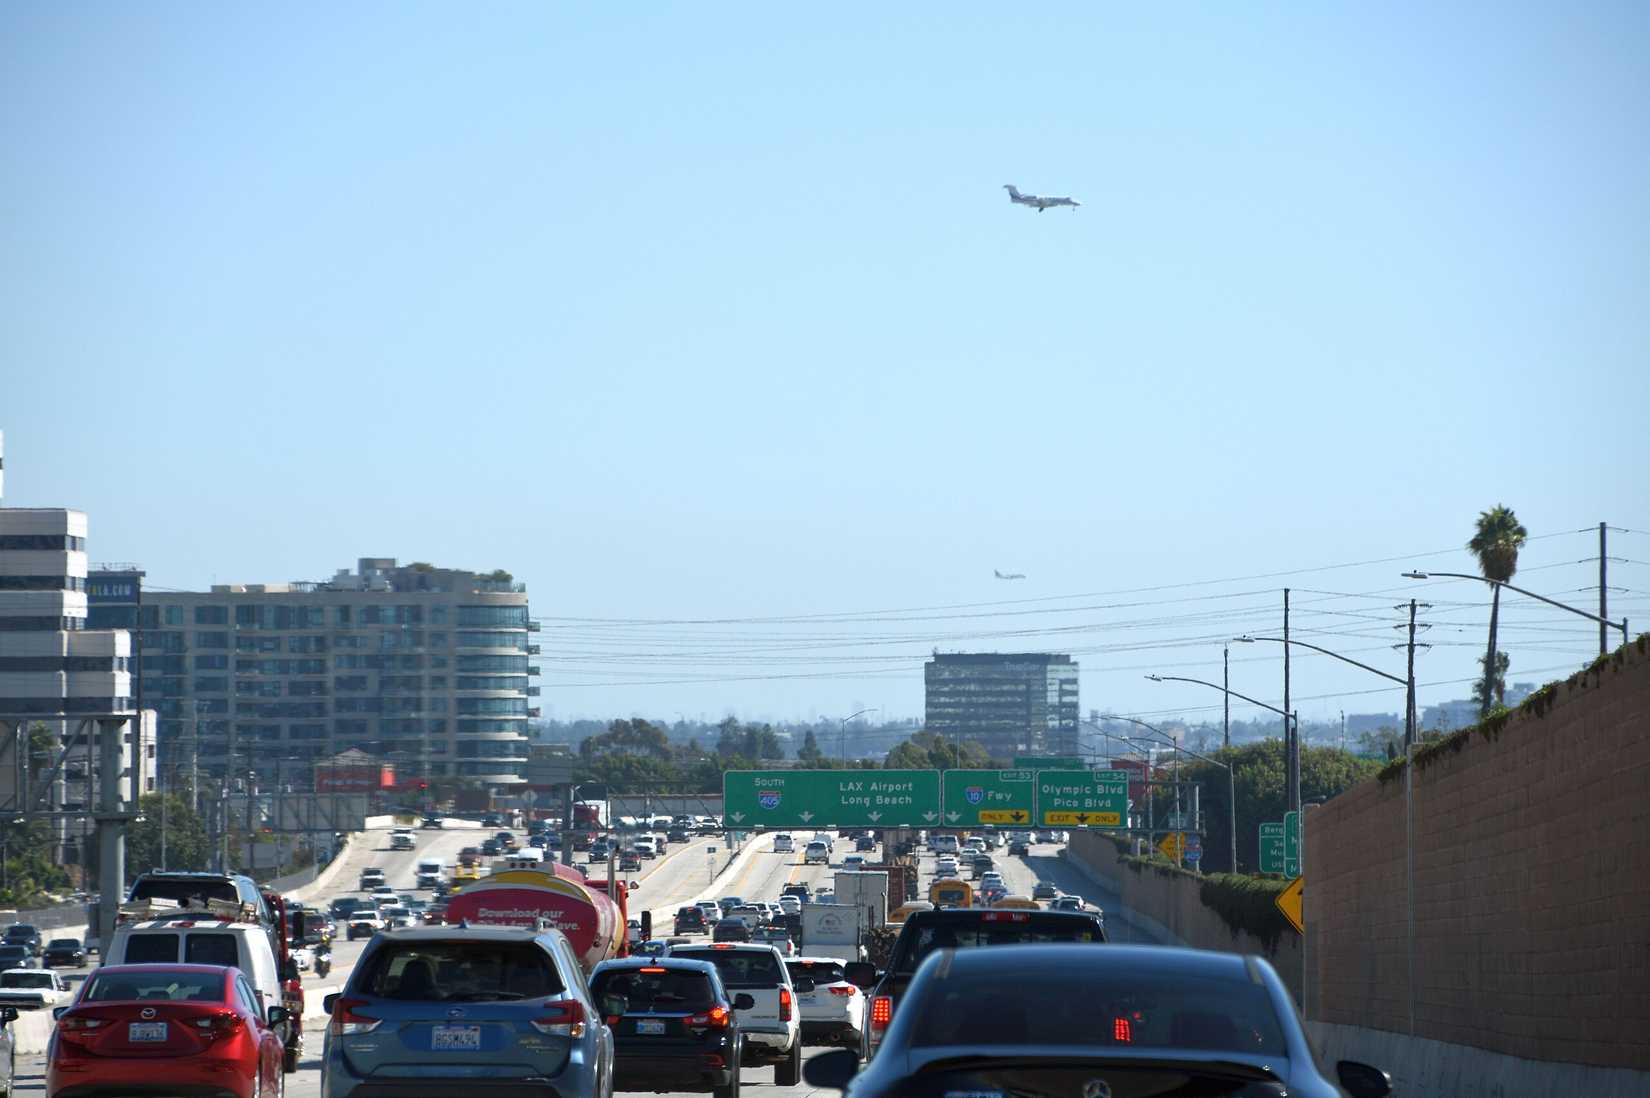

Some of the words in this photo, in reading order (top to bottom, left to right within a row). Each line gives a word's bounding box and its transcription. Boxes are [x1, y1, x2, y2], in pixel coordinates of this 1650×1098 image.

[839, 782, 863, 791] LAX
[870, 782, 913, 793] Airport
[1042, 784, 1091, 796] Olympic
[1097, 785, 1123, 794] Blvd
[759, 796, 778, 805] 405
[841, 795, 870, 807] Long
[876, 795, 912, 804] Beach
[987, 791, 1012, 801] Fwy
[1054, 799, 1078, 807] Pico
[1085, 799, 1111, 807] Blvd
[478, 908, 540, 918] Download
[543, 910, 564, 919] our
